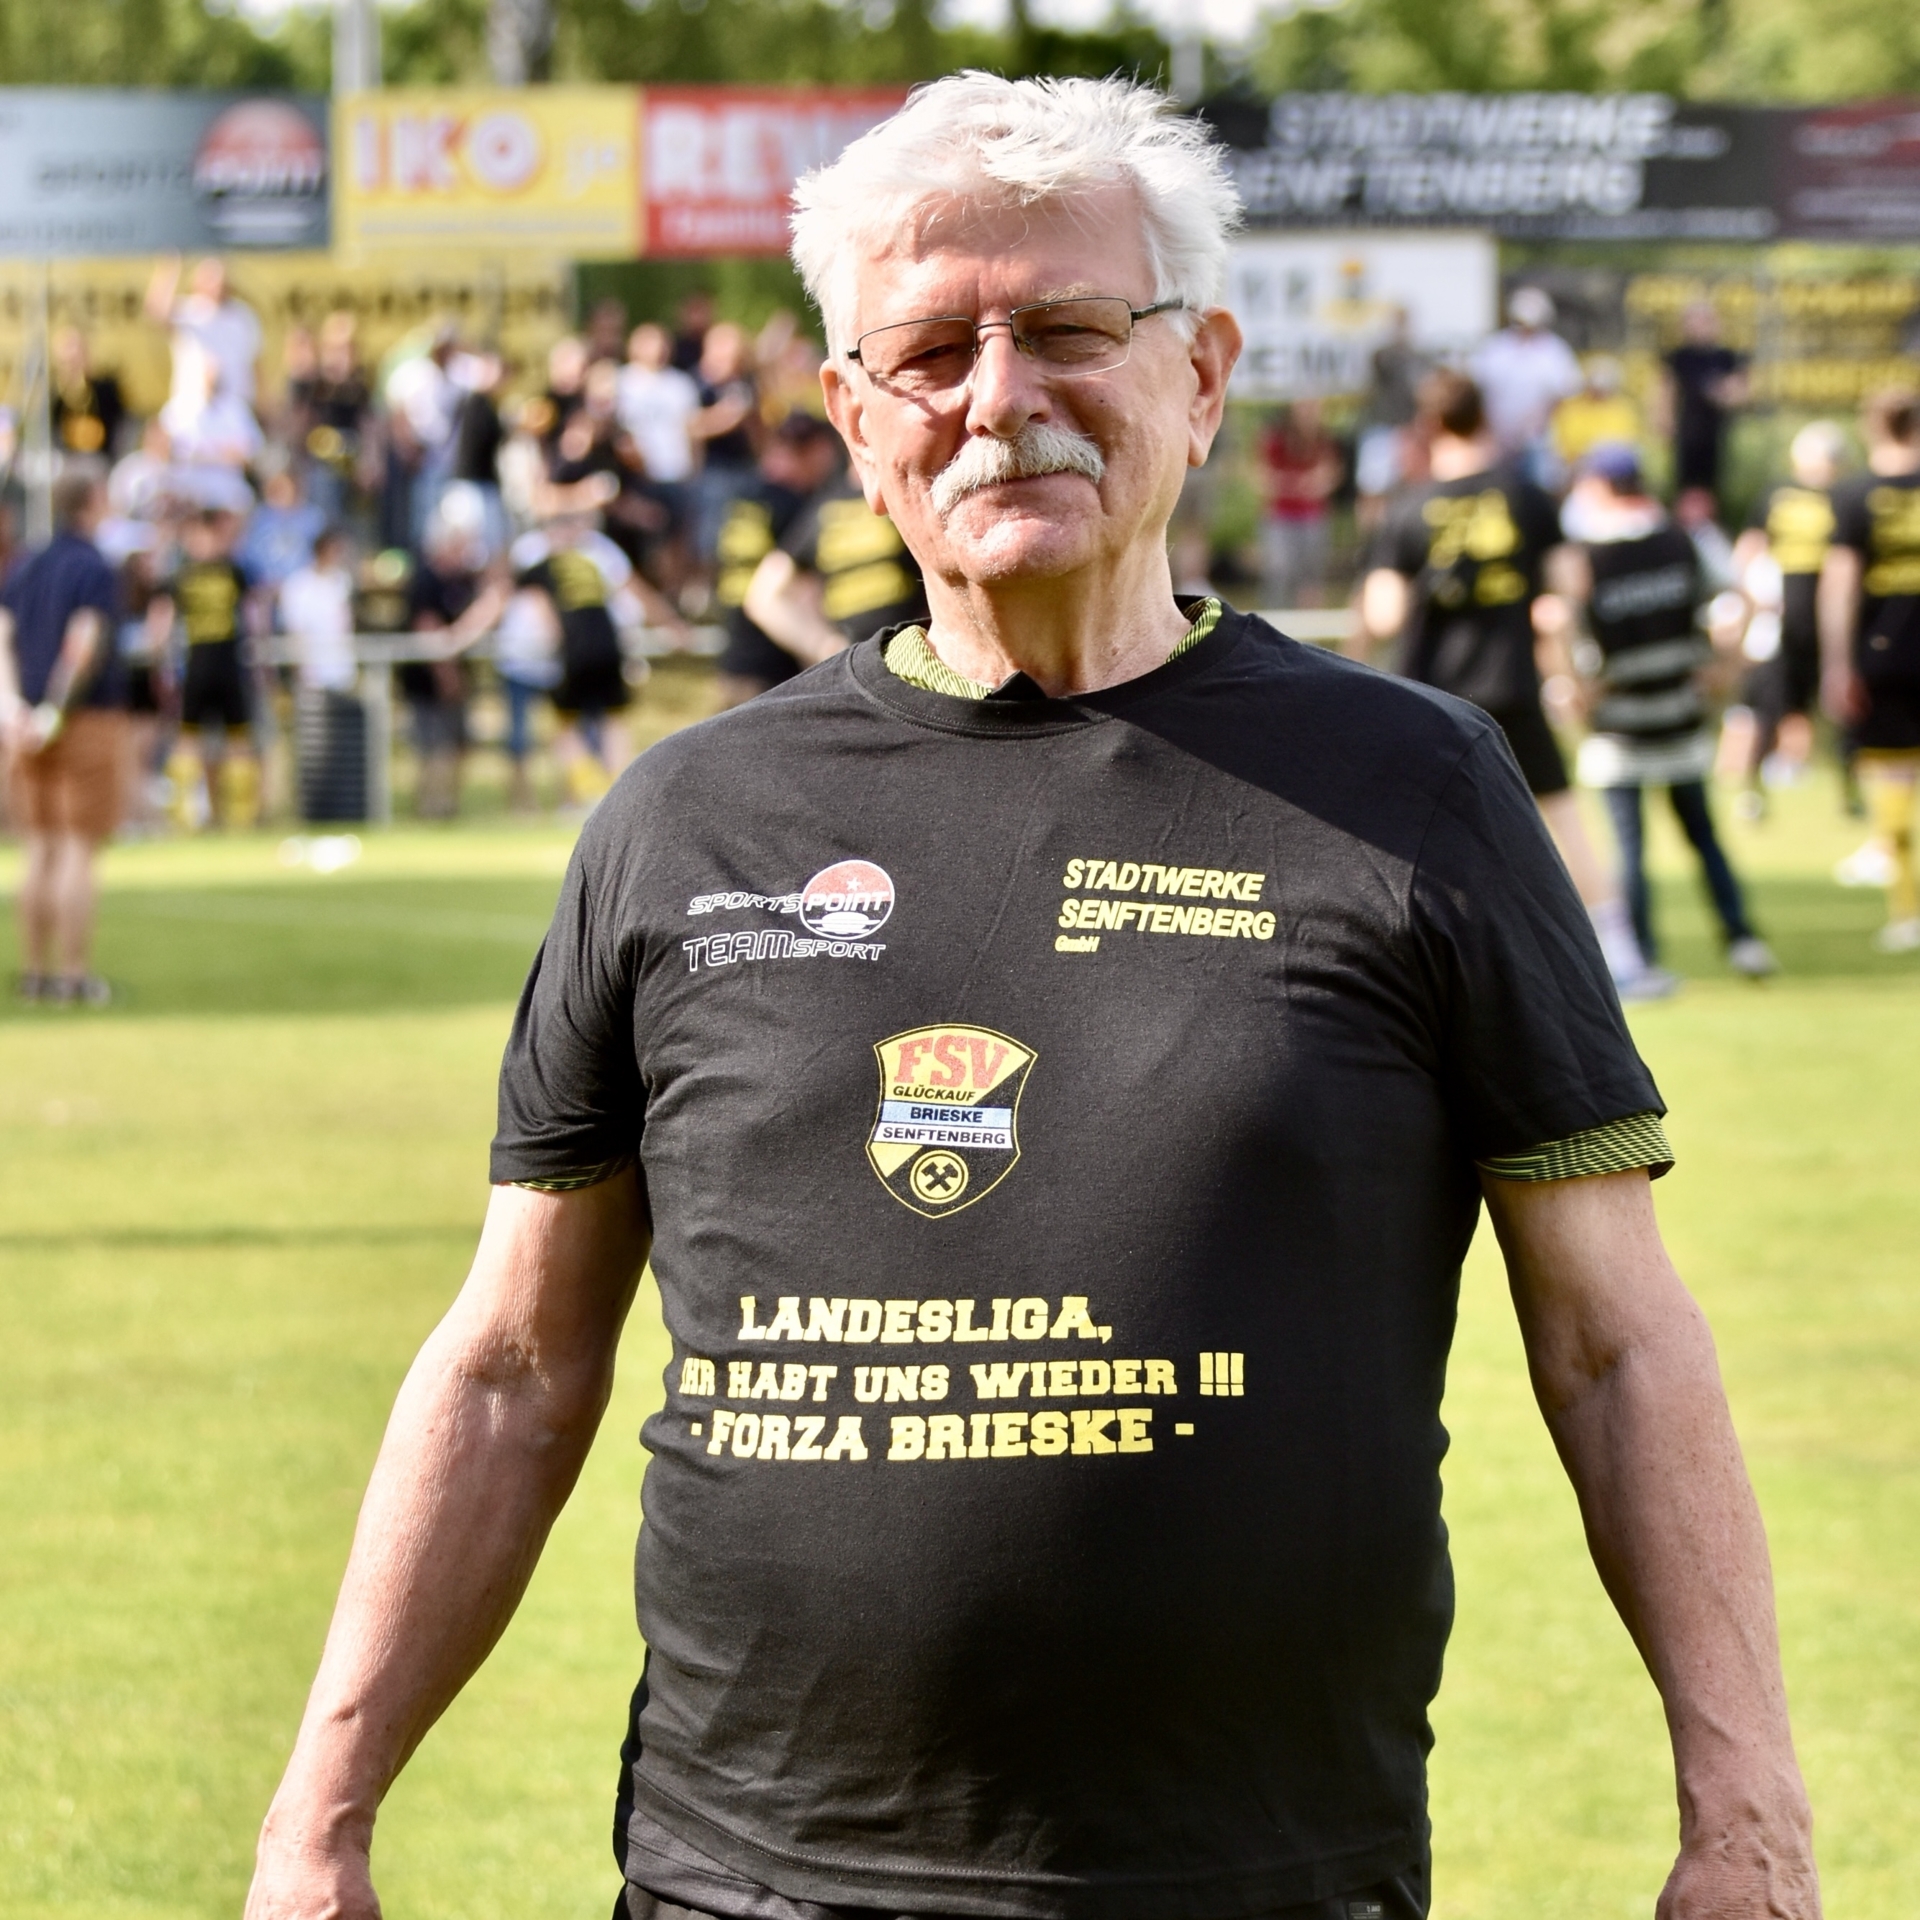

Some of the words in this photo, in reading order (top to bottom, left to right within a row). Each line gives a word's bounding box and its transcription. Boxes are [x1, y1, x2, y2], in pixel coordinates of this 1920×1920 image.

[1222, 150, 1648, 215] ENFTENBERG
[1063, 858, 1266, 901] STADTWERKE
[805, 890, 890, 912] POINT
[1058, 898, 1277, 940] SENFTENBERG
[1054, 934, 1101, 953] GmbH
[893, 1034, 1010, 1089] FSV
[892, 1084, 977, 1102] GLÜCKAUF
[882, 1126, 1007, 1145] SENFTENBERG
[910, 1106, 984, 1124] BRIESKE
[737, 1296, 1113, 1344] LANDESLIGA,
[727, 1361, 838, 1402] HABT
[854, 1364, 950, 1402] UNS
[970, 1358, 1178, 1400] WIEDER
[706, 1409, 869, 1461] FORZA
[887, 1408, 1154, 1461] BRIESKE
